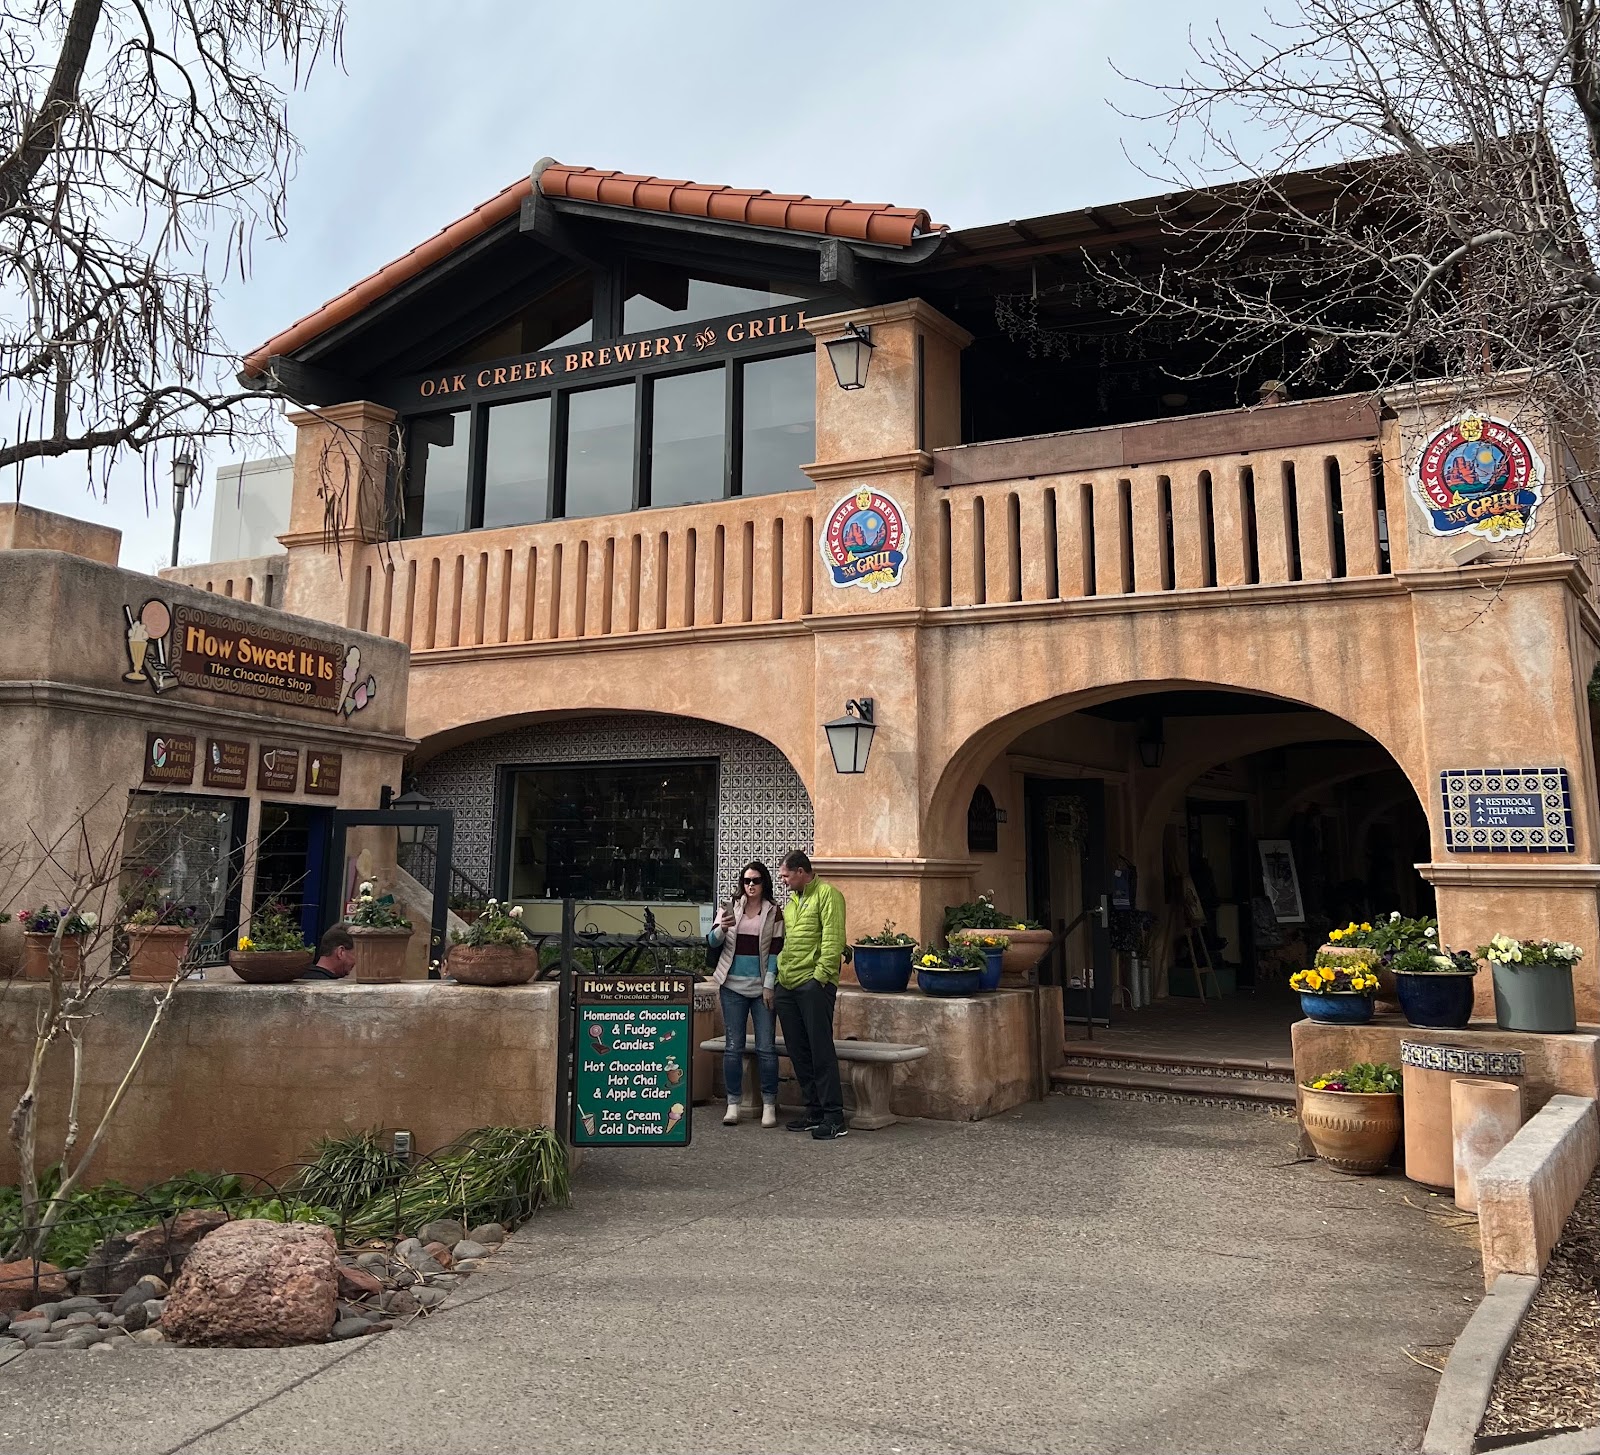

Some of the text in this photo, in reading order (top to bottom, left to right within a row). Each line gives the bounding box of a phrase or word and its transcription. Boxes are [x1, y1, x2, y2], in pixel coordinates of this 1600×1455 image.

[420, 374, 467, 397] OAK
[476, 358, 555, 388] CREEK
[564, 333, 688, 372] BREWERY
[1426, 432, 1458, 473] CREEK
[1426, 476, 1448, 504] OAK
[831, 498, 898, 561] OAK CREEK BREWERY
[856, 551, 896, 573] GRILL
[186, 626, 333, 680] How Sweet It Is
[210, 662, 312, 694] The Chocolate Shop
[169, 739, 193, 751] Fresh
[224, 743, 246, 755] Water
[170, 751, 191, 763] Fruit
[222, 754, 246, 766] Sodas
[149, 764, 193, 779] Smoothies
[208, 772, 245, 785] Lemonade
[1485, 797, 1531, 806] RESTROOM
[1487, 806, 1536, 815] TELEPHONE
[1487, 816, 1508, 825] ATM
[584, 981, 686, 993] How Sweet It Is
[651, 993, 670, 1001] Shop
[583, 1010, 686, 1021] Homemade Chocolate
[611, 1023, 657, 1038] & Fudge
[612, 1039, 655, 1051] Candies
[584, 1060, 663, 1072] Hot Chocolate
[608, 1074, 657, 1086] Hot Chai
[593, 1087, 671, 1101] & Apple Cider
[601, 1110, 661, 1121] Ice Cream
[599, 1123, 663, 1135] Cold Drinks
